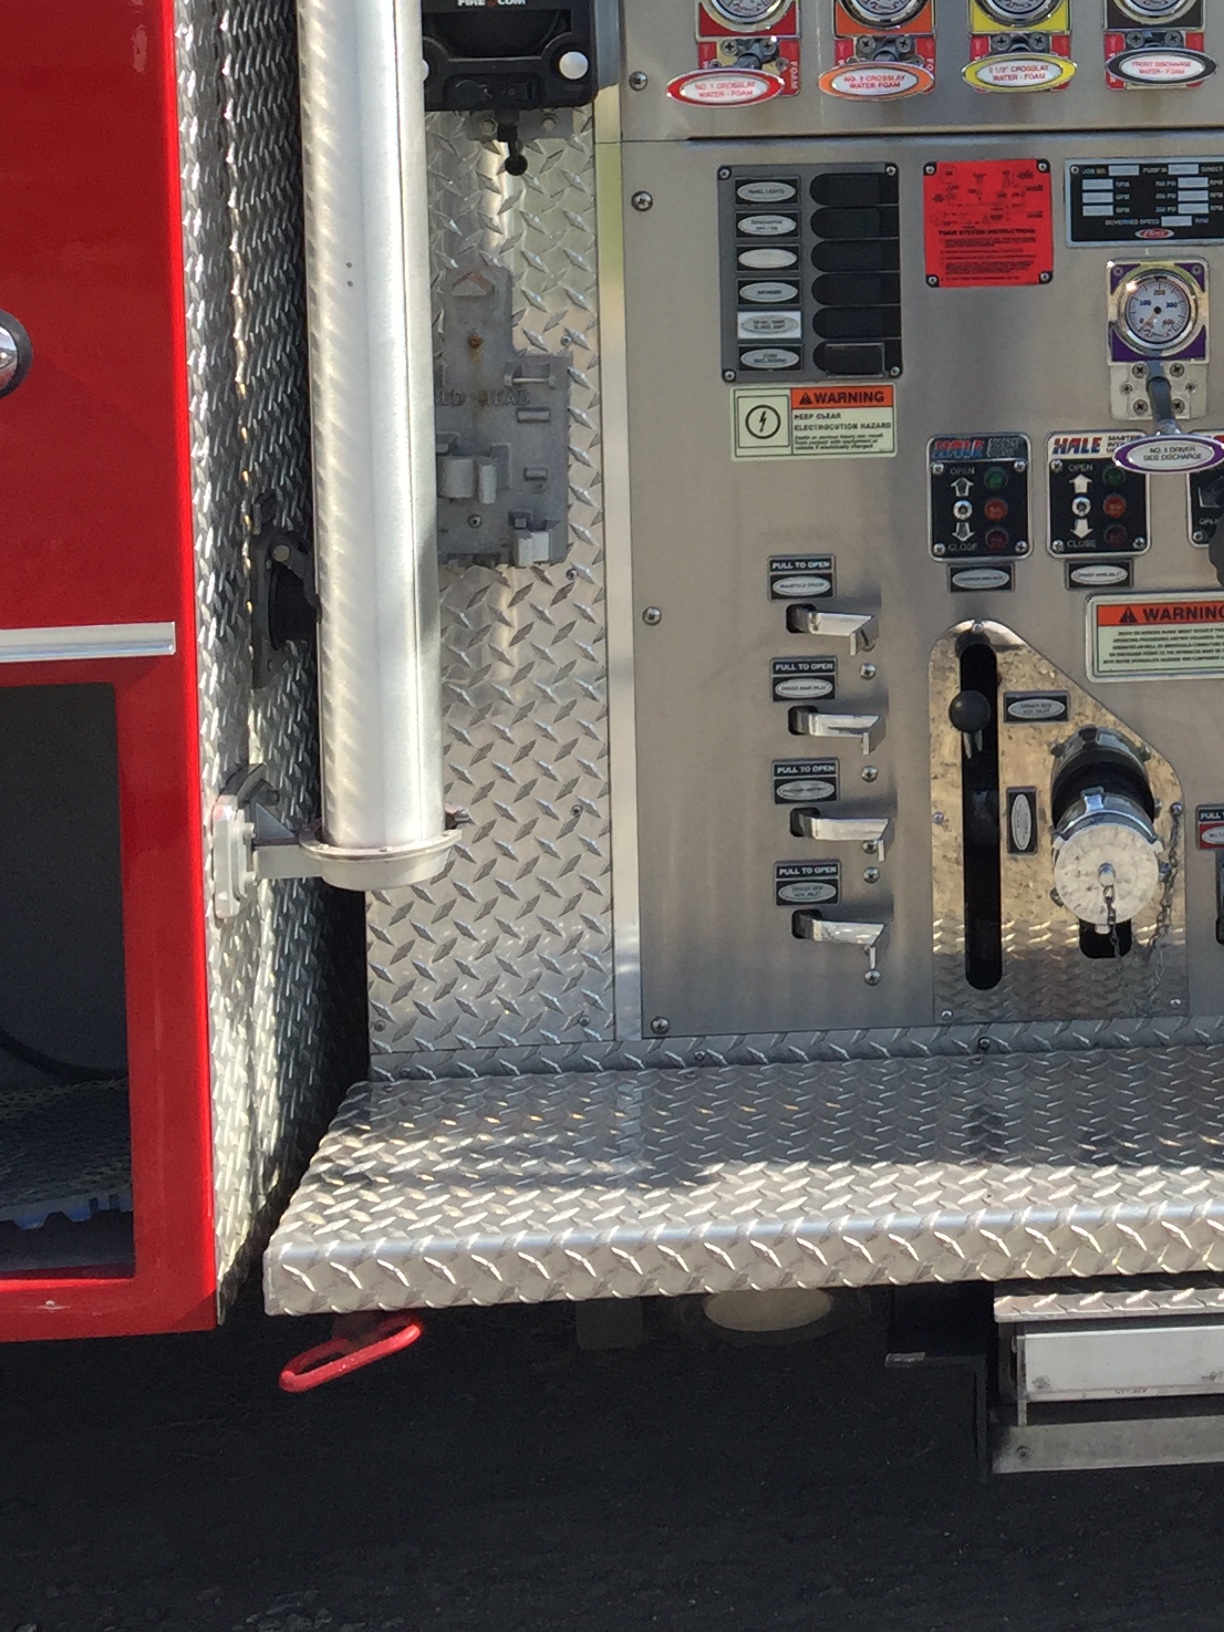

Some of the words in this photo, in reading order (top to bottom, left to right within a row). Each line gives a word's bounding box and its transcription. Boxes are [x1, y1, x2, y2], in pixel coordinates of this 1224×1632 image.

[1012, 65, 1050, 73] CROSSLAY
[716, 81, 756, 90] CROSSLAY
[732, 89, 753, 97] FOAM
[814, 391, 884, 403] WARNING
[1052, 437, 1102, 455] HALE
[950, 467, 975, 475] OPEN
[1067, 540, 1096, 548] CLOSE
